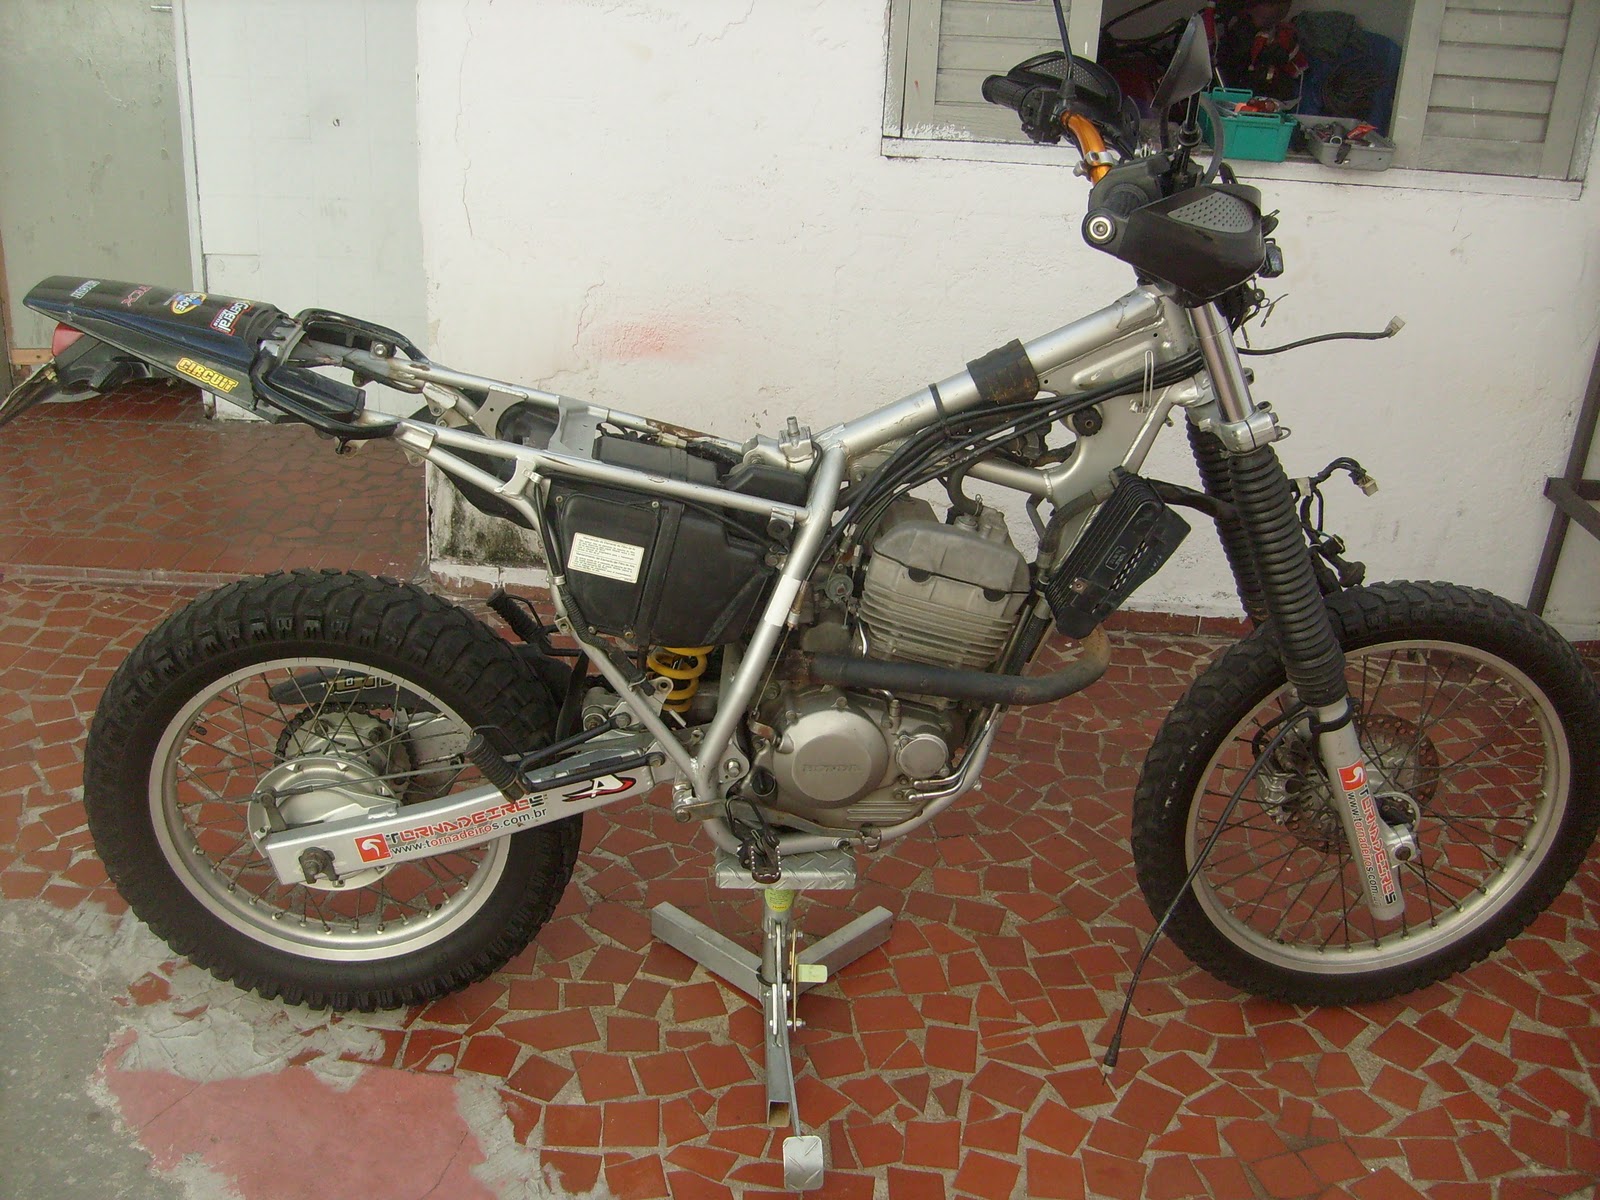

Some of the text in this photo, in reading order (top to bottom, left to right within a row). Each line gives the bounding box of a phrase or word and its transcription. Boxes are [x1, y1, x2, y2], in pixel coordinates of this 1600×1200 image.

[177, 358, 237, 392] CIRCUIT
[386, 795, 545, 844] TORNADEIROS
[391, 808, 547, 854] www.tornadeiros.com.br
[1347, 791, 1381, 905] www.tornadeiros.com.
[1360, 785, 1396, 904] TORNADEIROS
